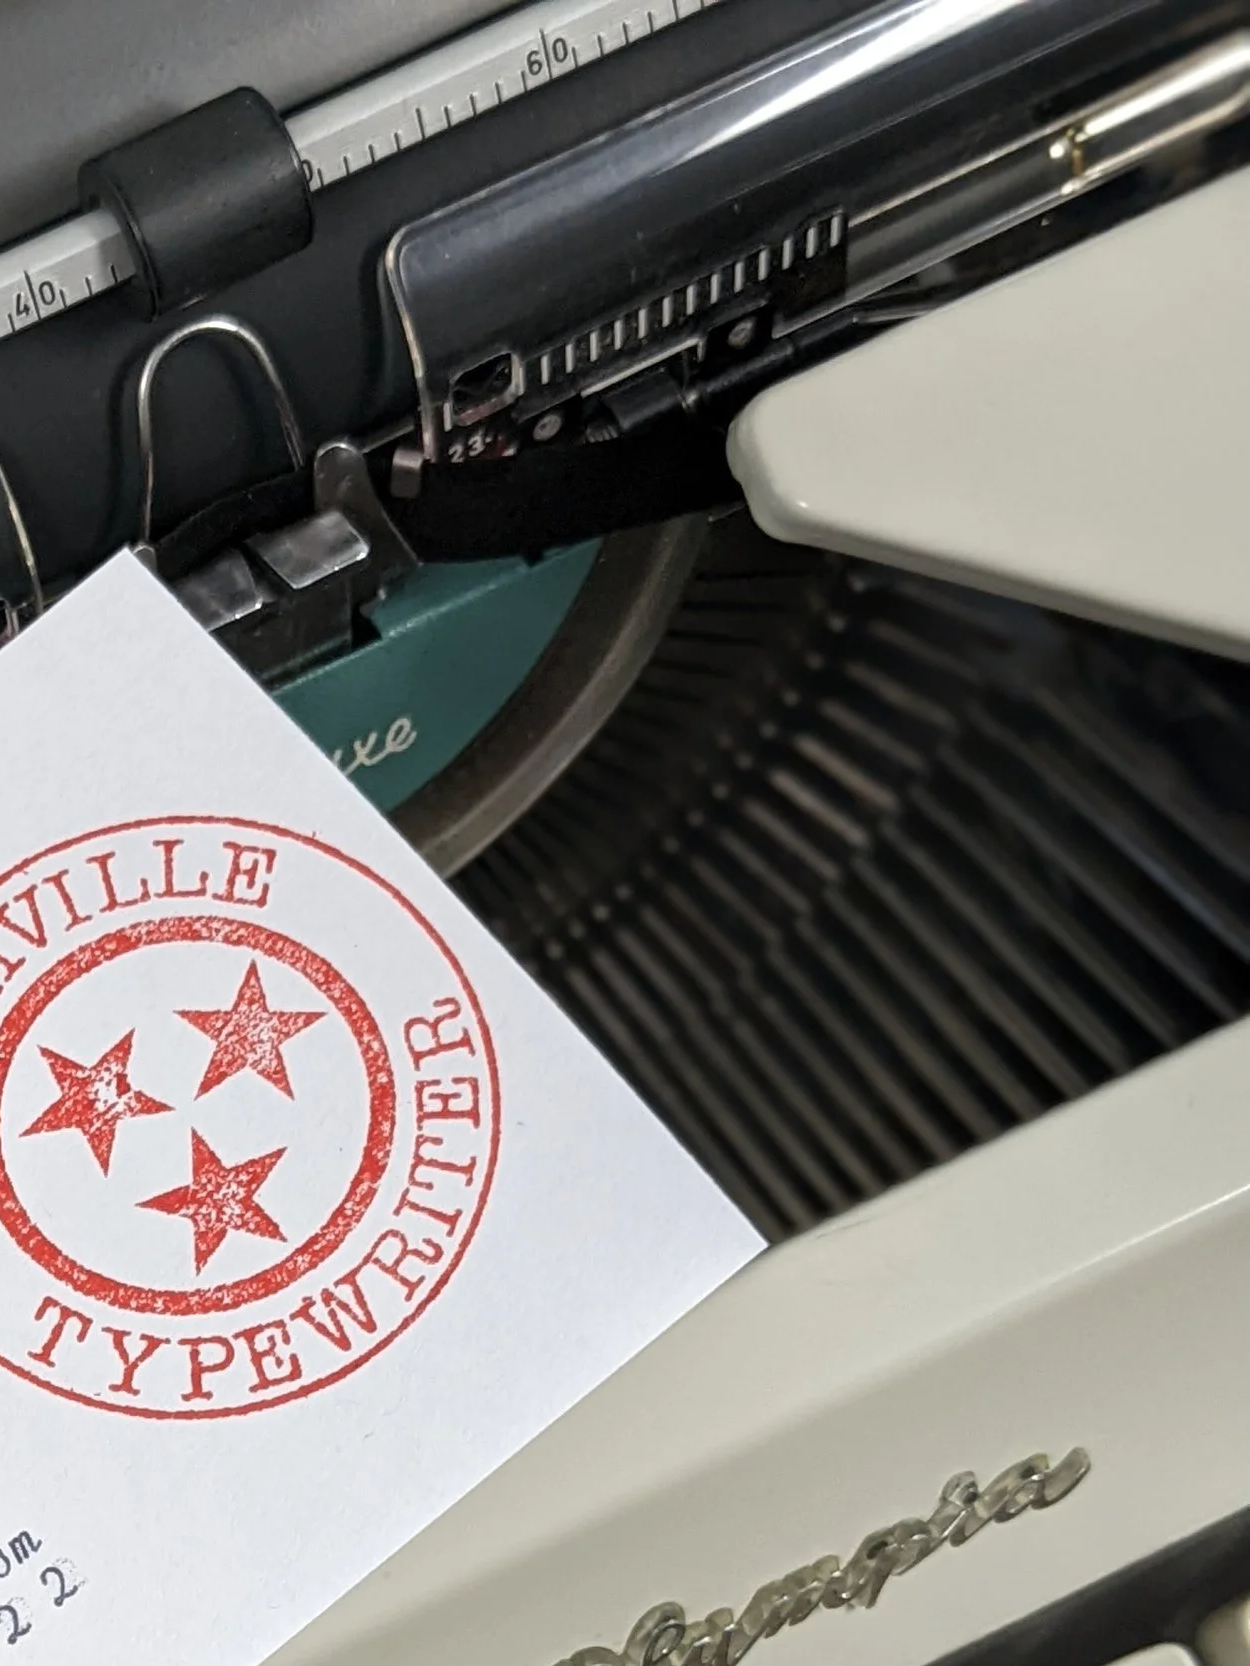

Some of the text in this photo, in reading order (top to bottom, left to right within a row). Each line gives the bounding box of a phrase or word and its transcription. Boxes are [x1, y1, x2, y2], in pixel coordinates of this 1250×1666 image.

[526, 37, 569, 76] 60
[15, 281, 56, 317] 40
[28, 996, 481, 1402] TYPEWRITER
